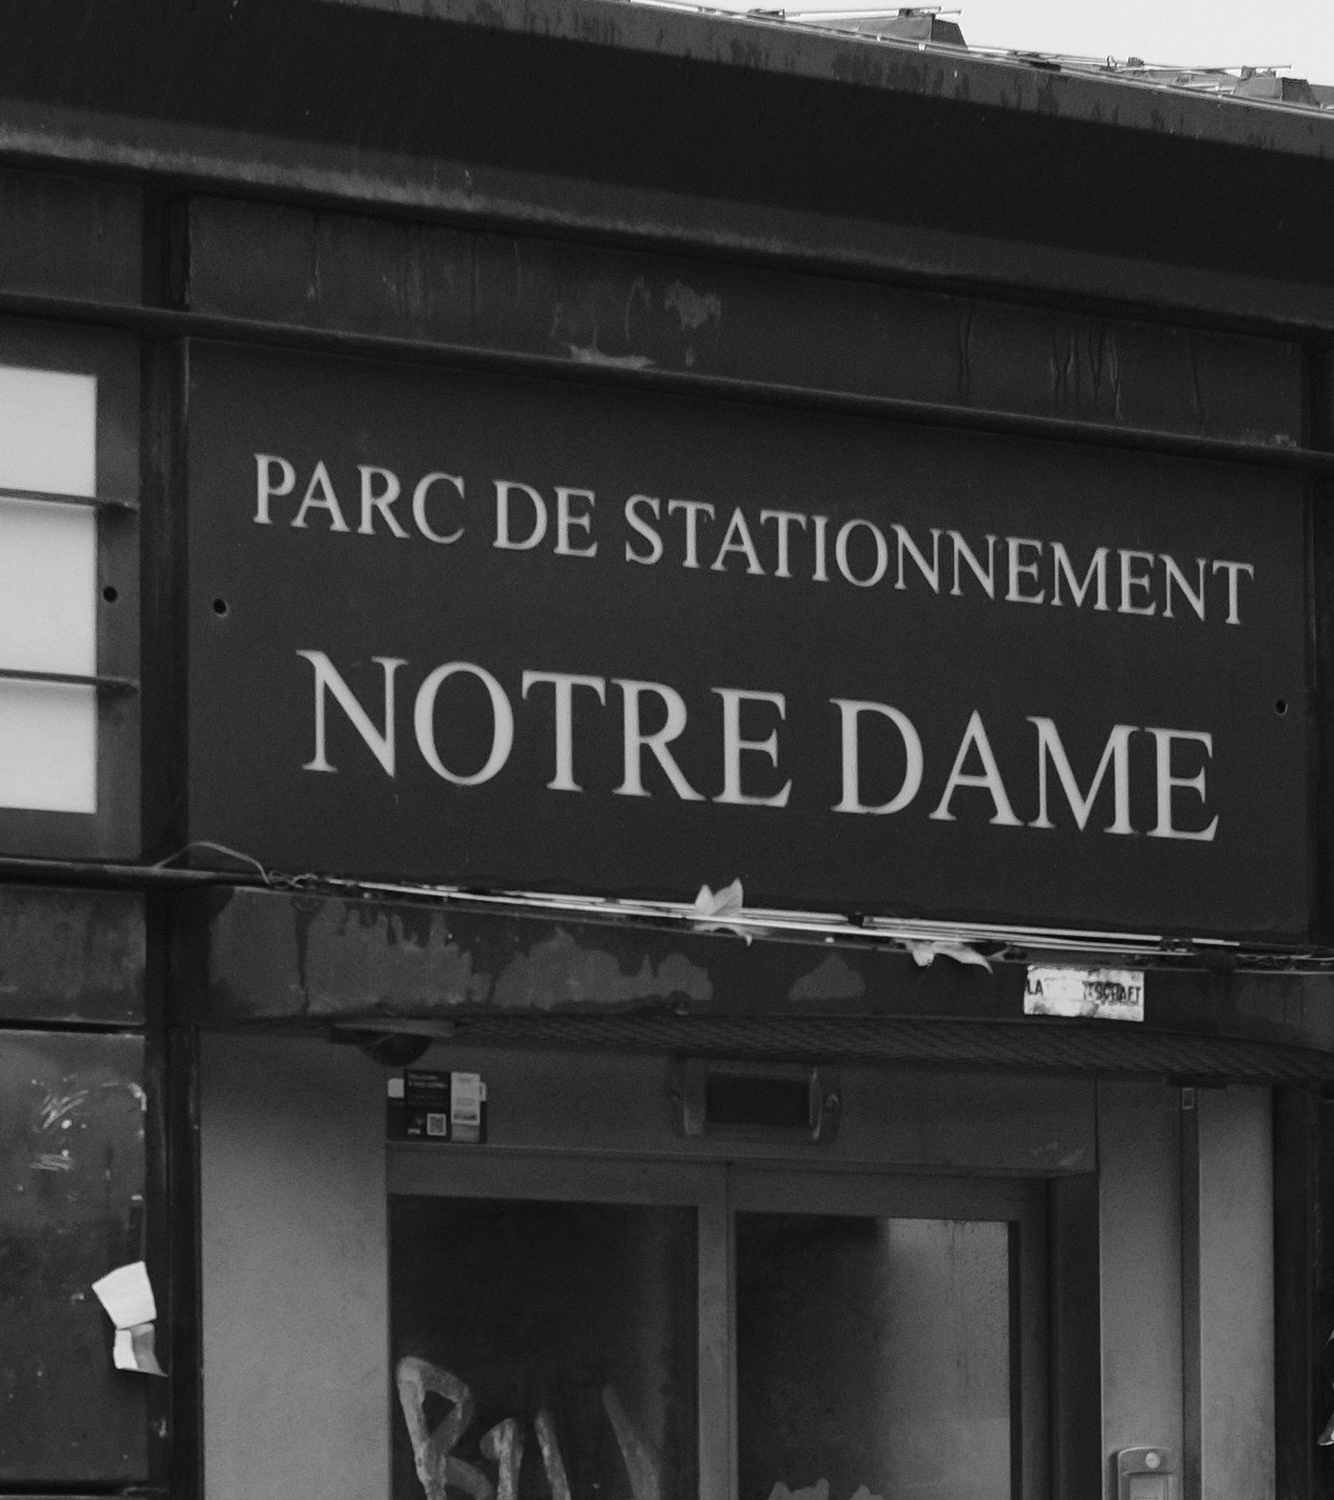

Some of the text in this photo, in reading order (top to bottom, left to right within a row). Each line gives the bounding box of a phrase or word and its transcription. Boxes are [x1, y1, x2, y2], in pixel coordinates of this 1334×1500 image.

[253, 453, 1254, 625] PARC DE STATIONNEMENT
[296, 650, 1219, 842] NOTRE DAME
